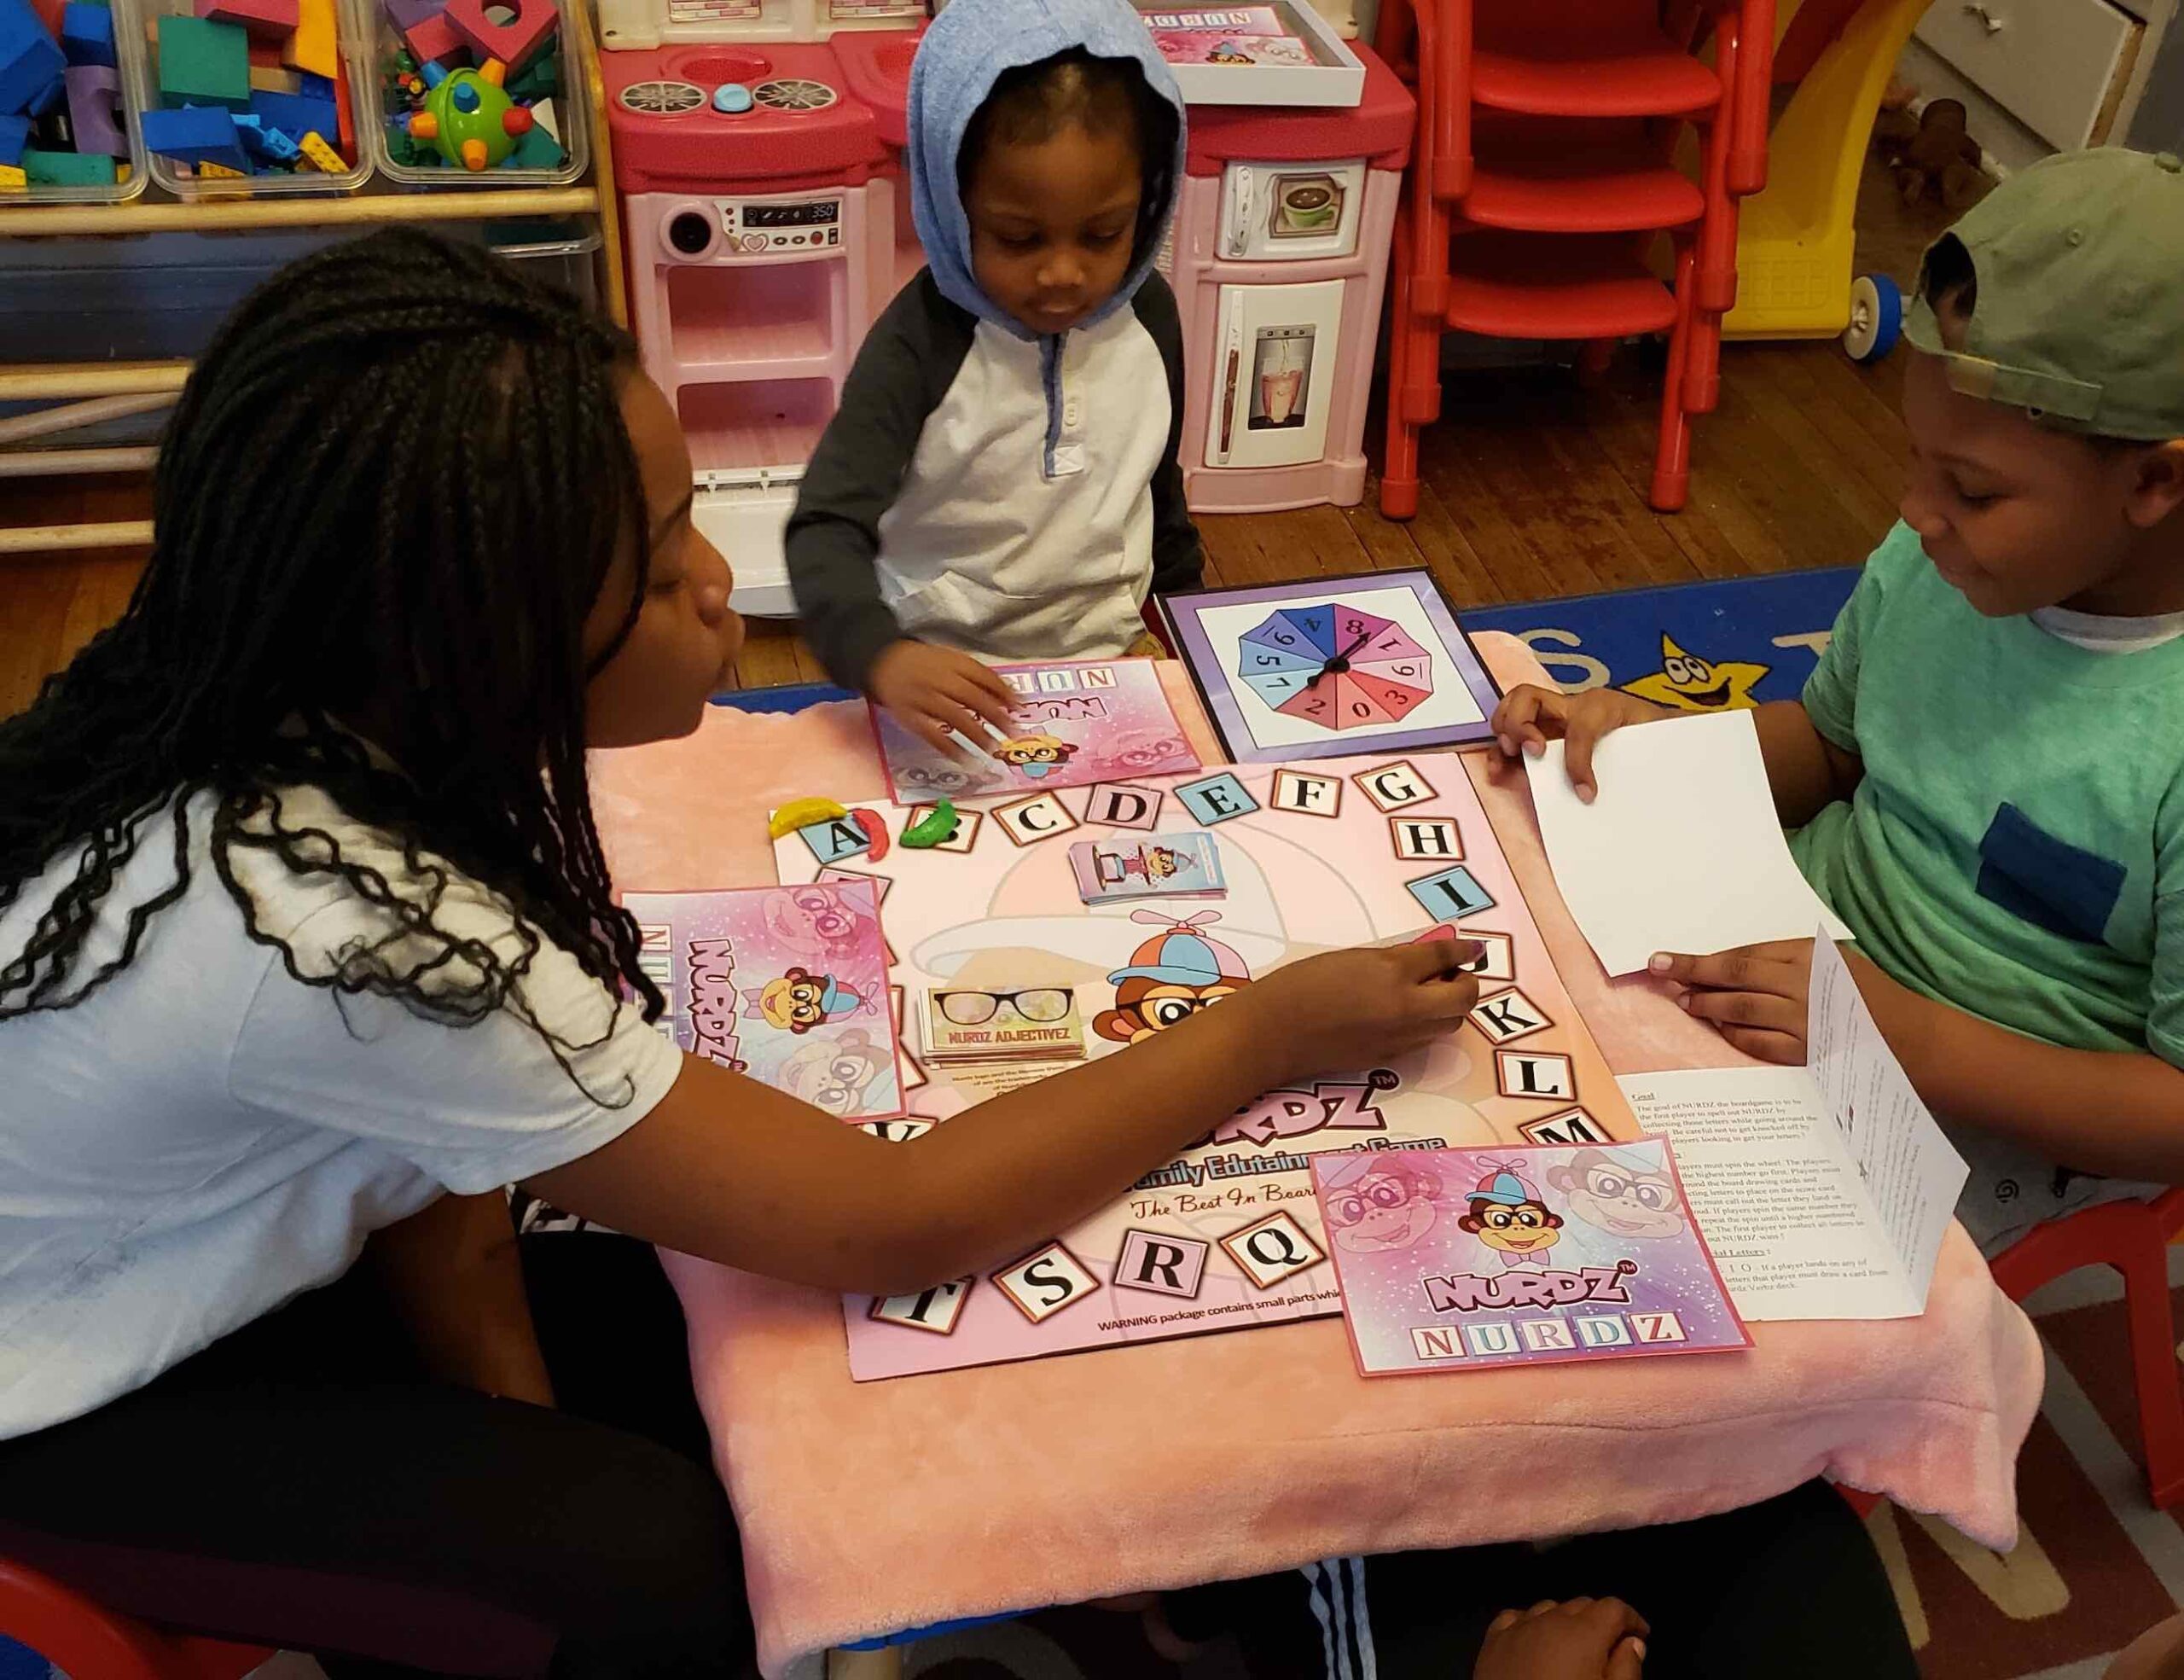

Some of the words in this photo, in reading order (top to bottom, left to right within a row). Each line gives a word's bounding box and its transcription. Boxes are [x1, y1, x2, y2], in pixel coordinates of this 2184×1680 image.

[812, 206, 834, 218] 350
[1303, 616, 1321, 632] 4
[1345, 619, 1365, 635] 8
[1380, 638, 1402, 652] 1
[1256, 654, 1281, 666] 5
[1517, 628, 1611, 694] S
[1266, 677, 1290, 689] 7
[1305, 699, 1326, 715] 2
[1352, 701, 1370, 718] 0
[1385, 689, 1409, 706] 3
[831, 823, 871, 855] A
[1018, 804, 1058, 832] C
[1106, 793, 1146, 822] D
[1199, 785, 1240, 817] E
[1292, 779, 1325, 808] F
[1375, 772, 1417, 801] G
[1405, 825, 1453, 854] H
[1433, 879, 1474, 912] I
[687, 939, 740, 1062] NURDZ
[1475, 997, 1538, 1036] K
[948, 1031, 992, 1044] NURDZ
[996, 1028, 1070, 1043] ADJECTIVEZ
[1516, 1061, 1558, 1095] L
[1182, 1084, 1387, 1148] RDZ
[1655, 1103, 1670, 1112] goal
[1534, 1117, 1600, 1143] M
[1123, 1159, 1205, 1187] amily
[1130, 1200, 1170, 1218] The
[1174, 1195, 1223, 1212] Best
[1227, 1189, 1255, 1206] In
[1259, 1184, 1316, 1200] Boar
[1024, 1258, 1074, 1305] S
[1136, 1241, 1185, 1289] R
[1246, 1228, 1309, 1266] Q
[1740, 1264, 1751, 1272] O
[1424, 1265, 1631, 1312] NURDZ
[1098, 1315, 1158, 1331] WARNING
[1160, 1308, 1205, 1324] package
[1208, 1301, 1254, 1316] contains
[1257, 1296, 1285, 1310] small
[1287, 1292, 1315, 1306] parts
